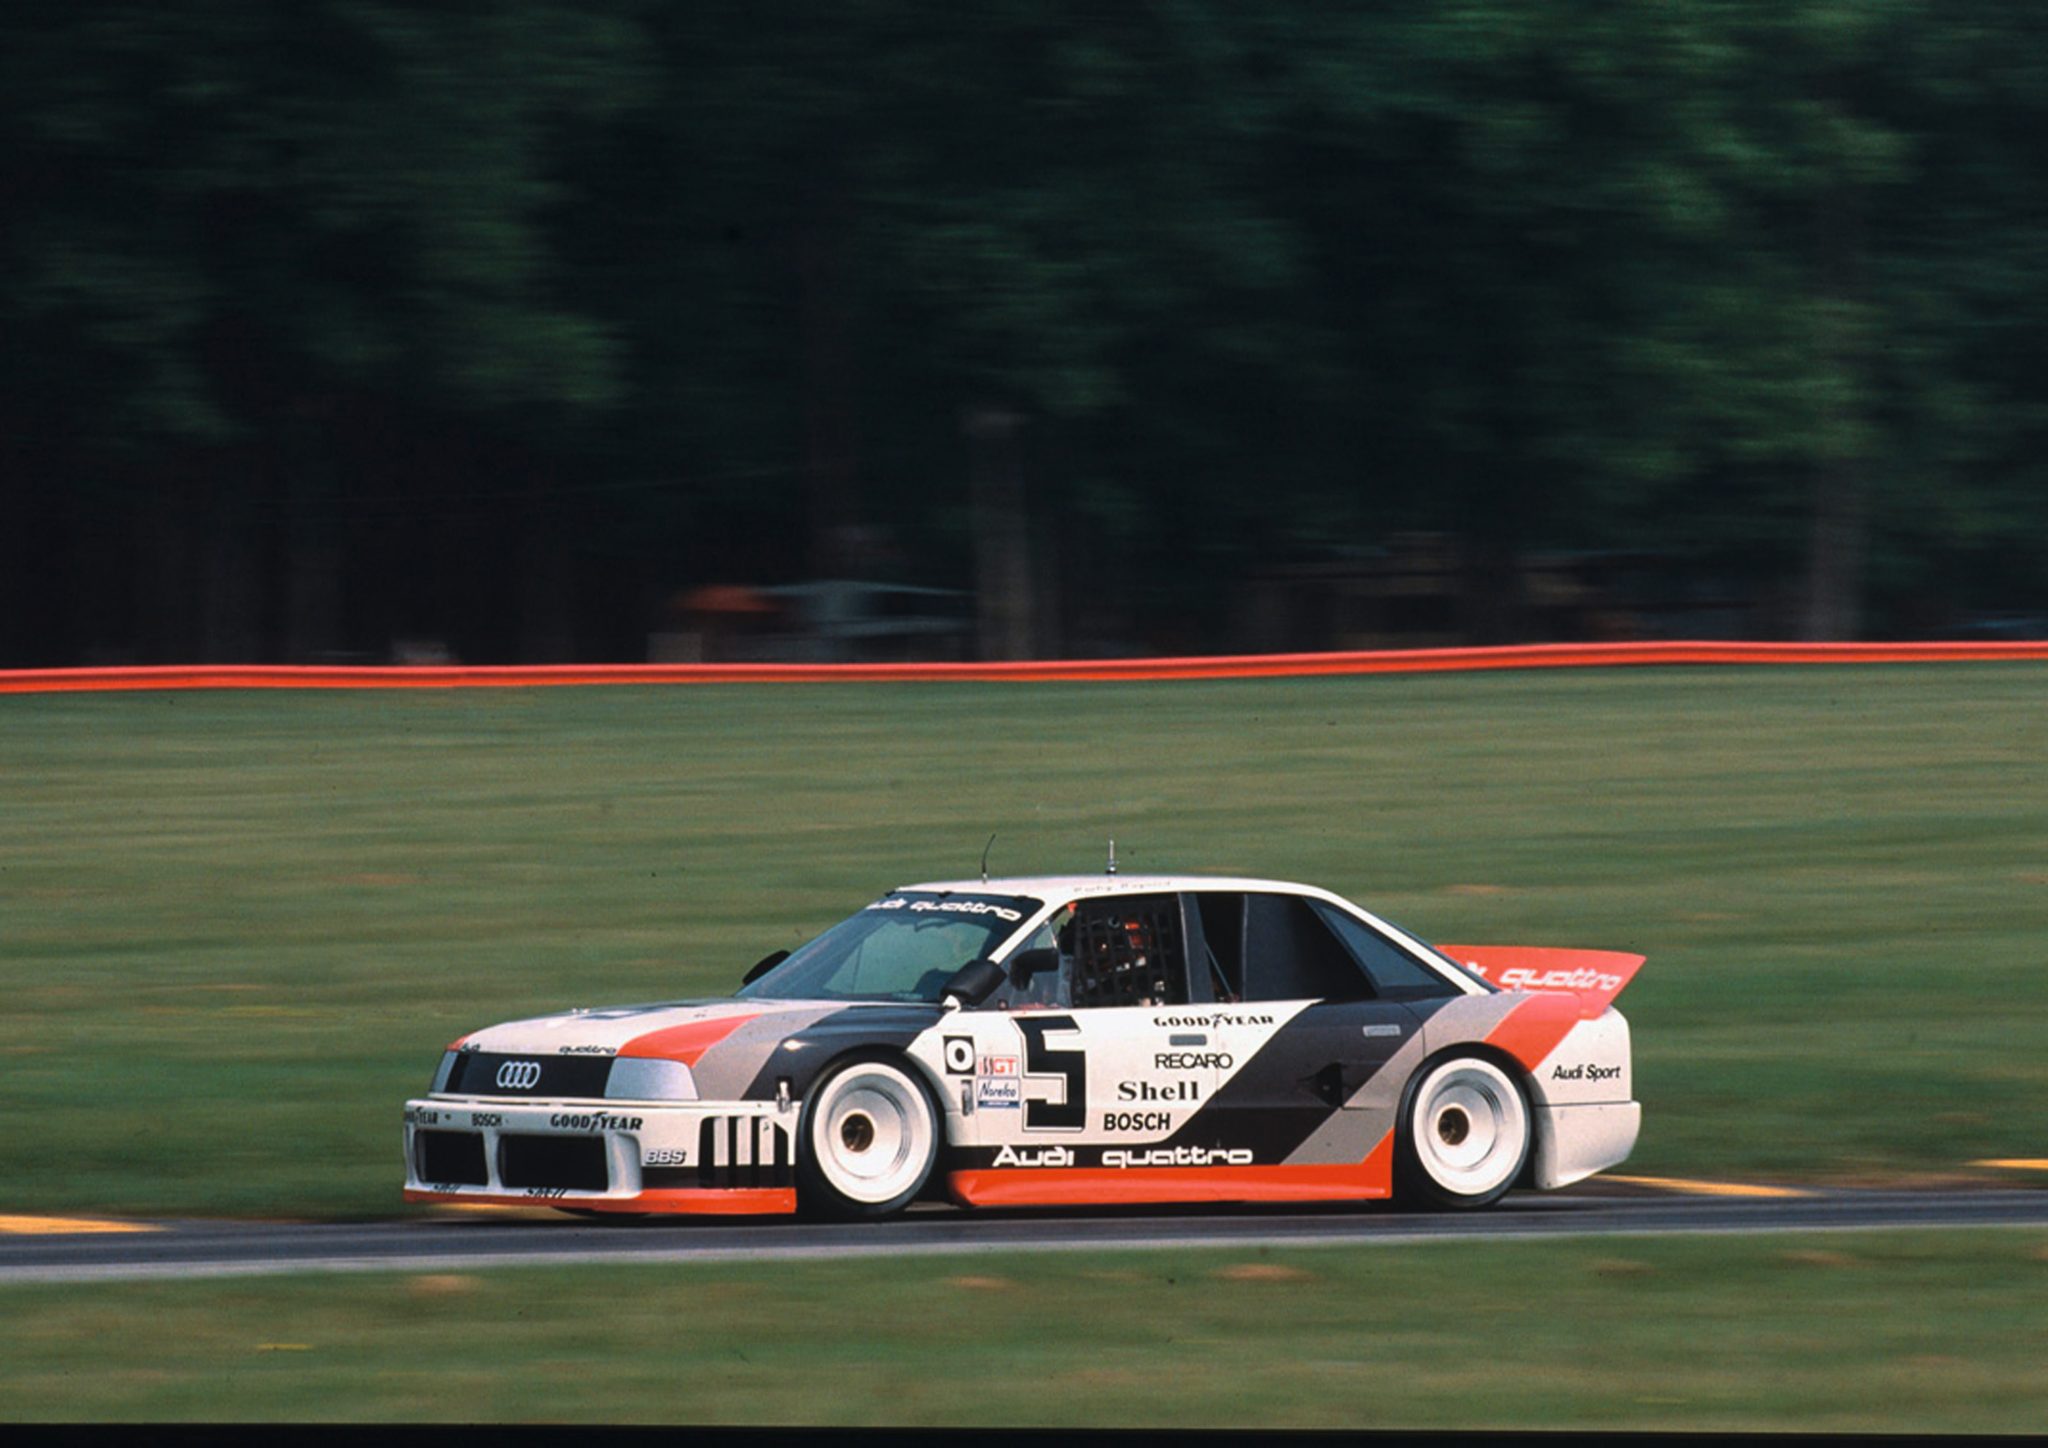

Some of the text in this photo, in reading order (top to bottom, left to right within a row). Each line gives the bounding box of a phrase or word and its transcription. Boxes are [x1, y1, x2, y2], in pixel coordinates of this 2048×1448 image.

[910, 900, 1022, 921] quattro
[1500, 968, 1622, 991] quattro
[558, 1044, 616, 1055] quattro
[1155, 1053, 1233, 1069] RECARO
[1010, 1015, 1087, 1133] 5
[1552, 1064, 1621, 1082] Audi Sport
[1117, 1081, 1199, 1101] Shell
[472, 1113, 502, 1127] BOSCH
[1103, 1113, 1171, 1131] BOSCH
[645, 1150, 687, 1165] BBS
[992, 1145, 1253, 1169] Audi quattro
